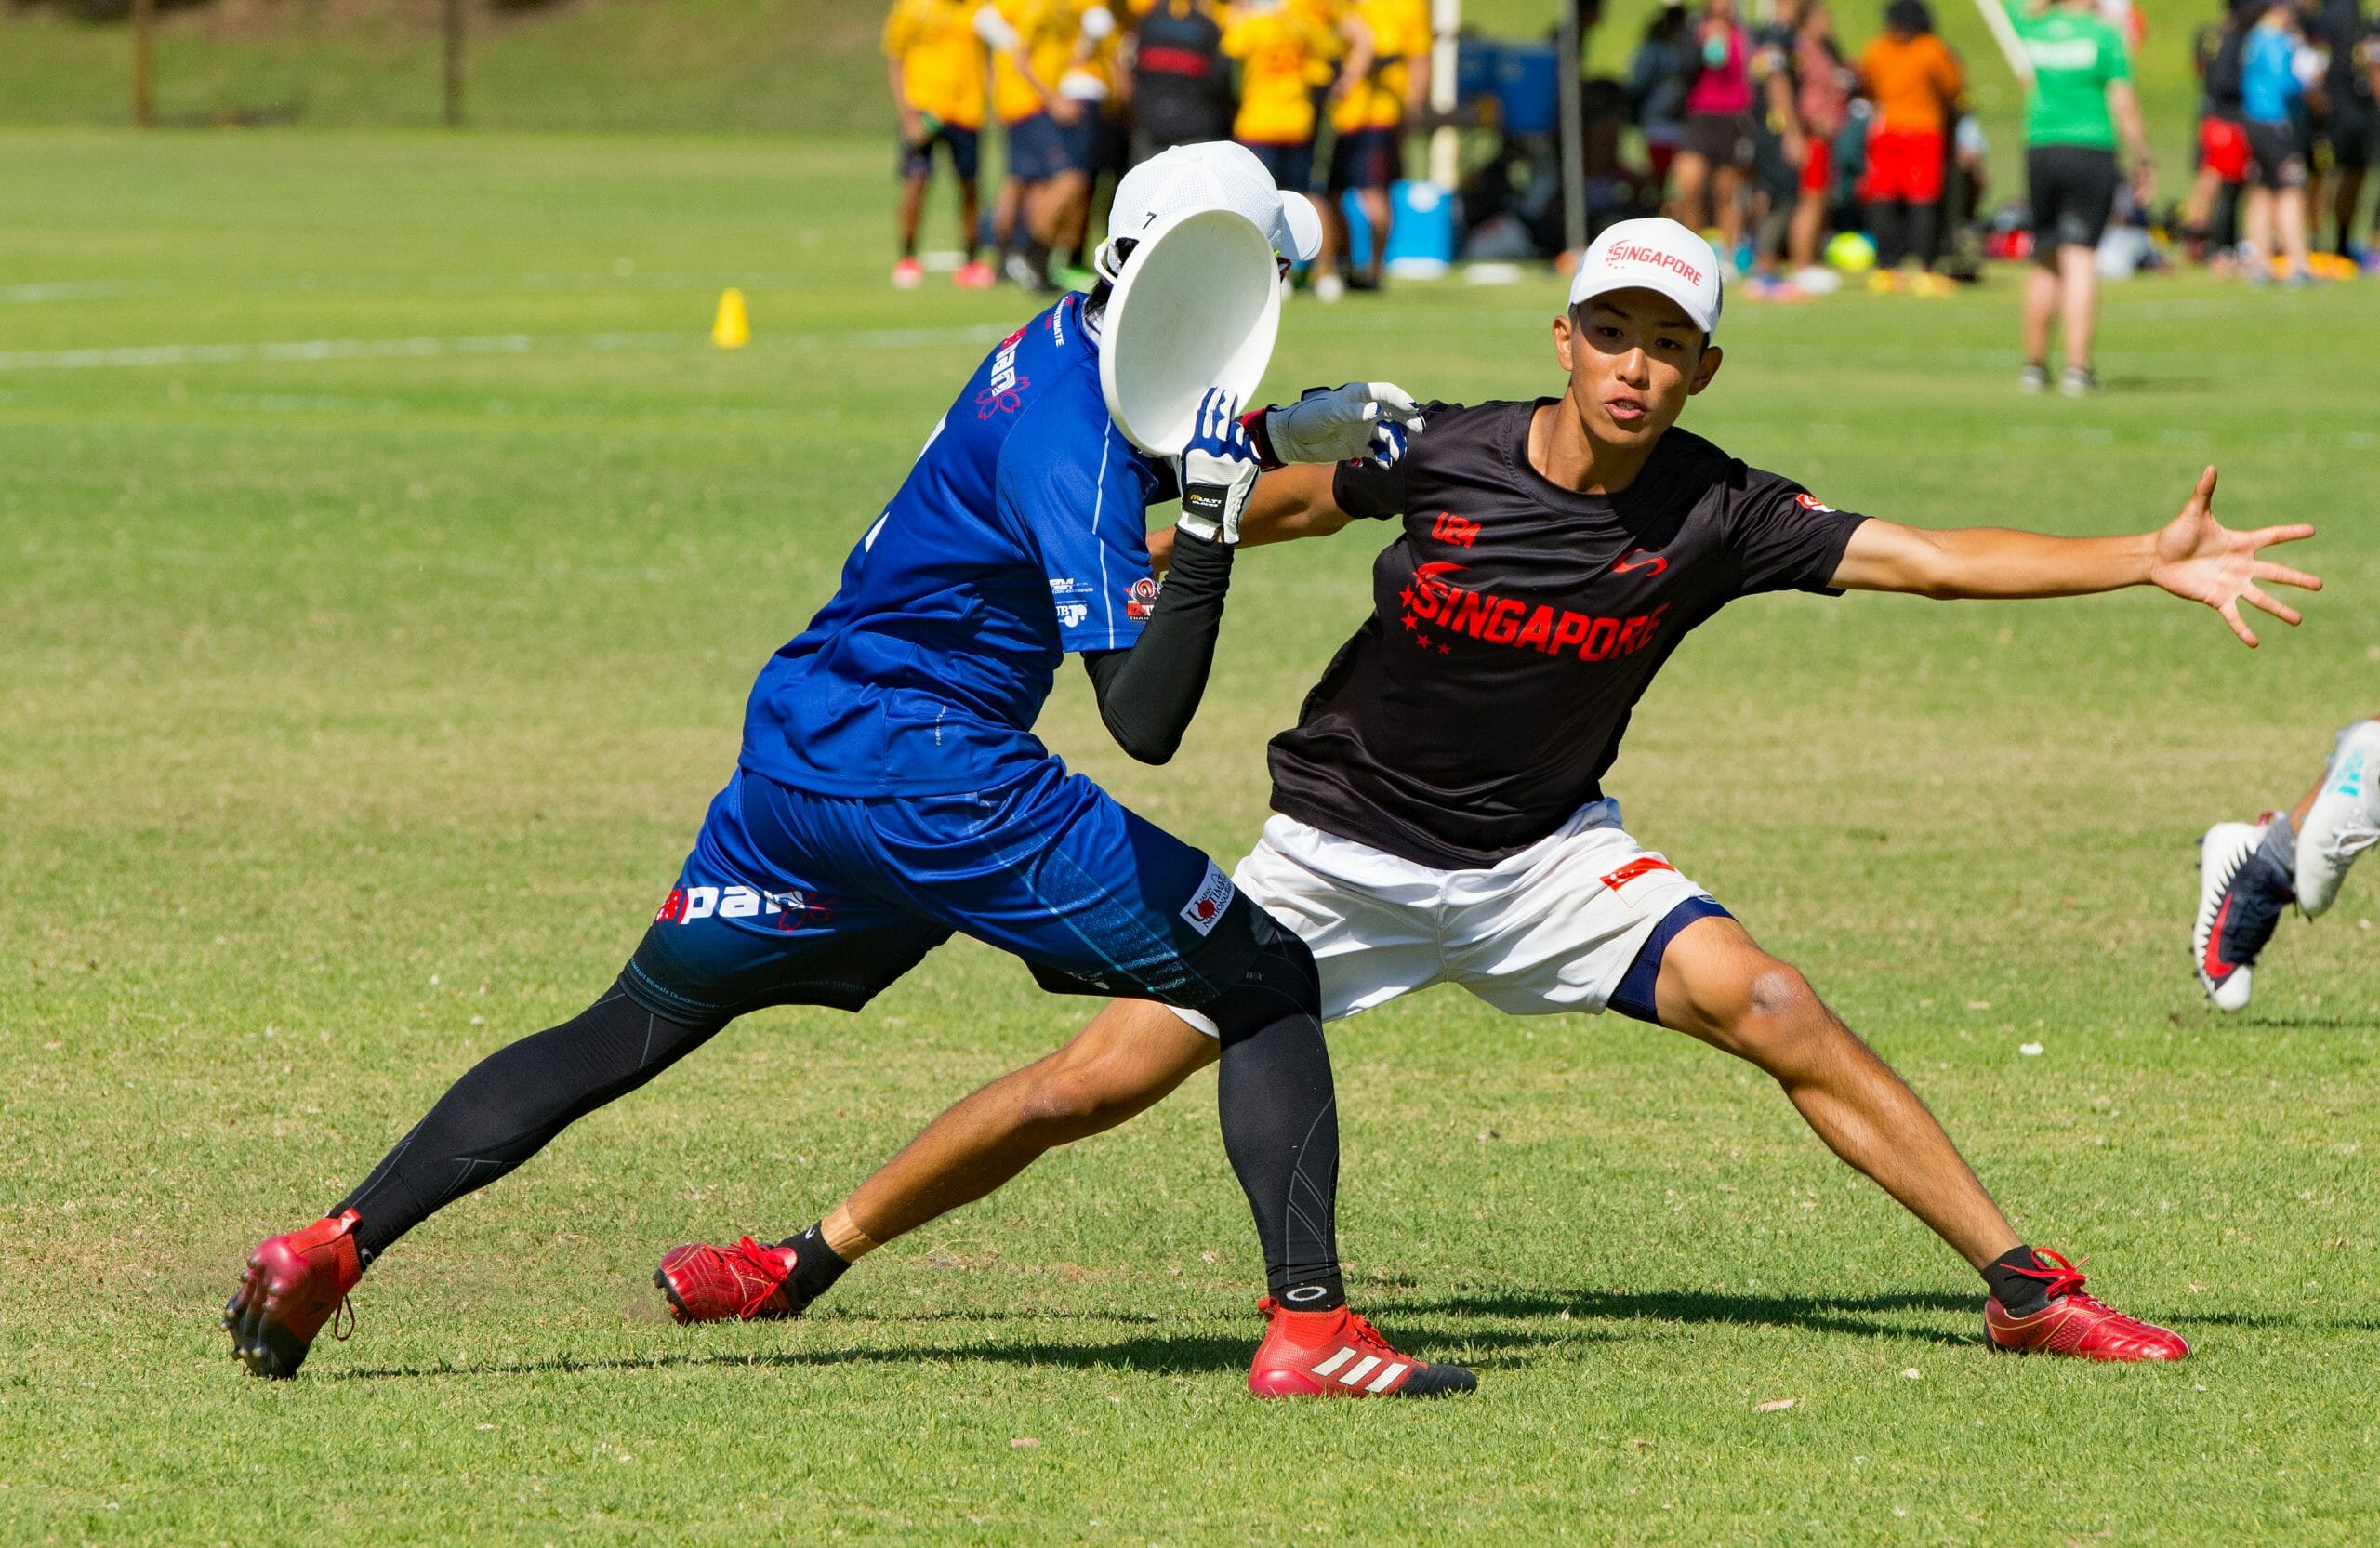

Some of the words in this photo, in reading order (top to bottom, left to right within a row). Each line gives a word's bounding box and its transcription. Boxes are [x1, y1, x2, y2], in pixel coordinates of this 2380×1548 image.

[1611, 245, 1703, 287] SINGAPORE
[1431, 511, 1482, 549] U24
[1411, 576, 1671, 662] SINGAPORE
